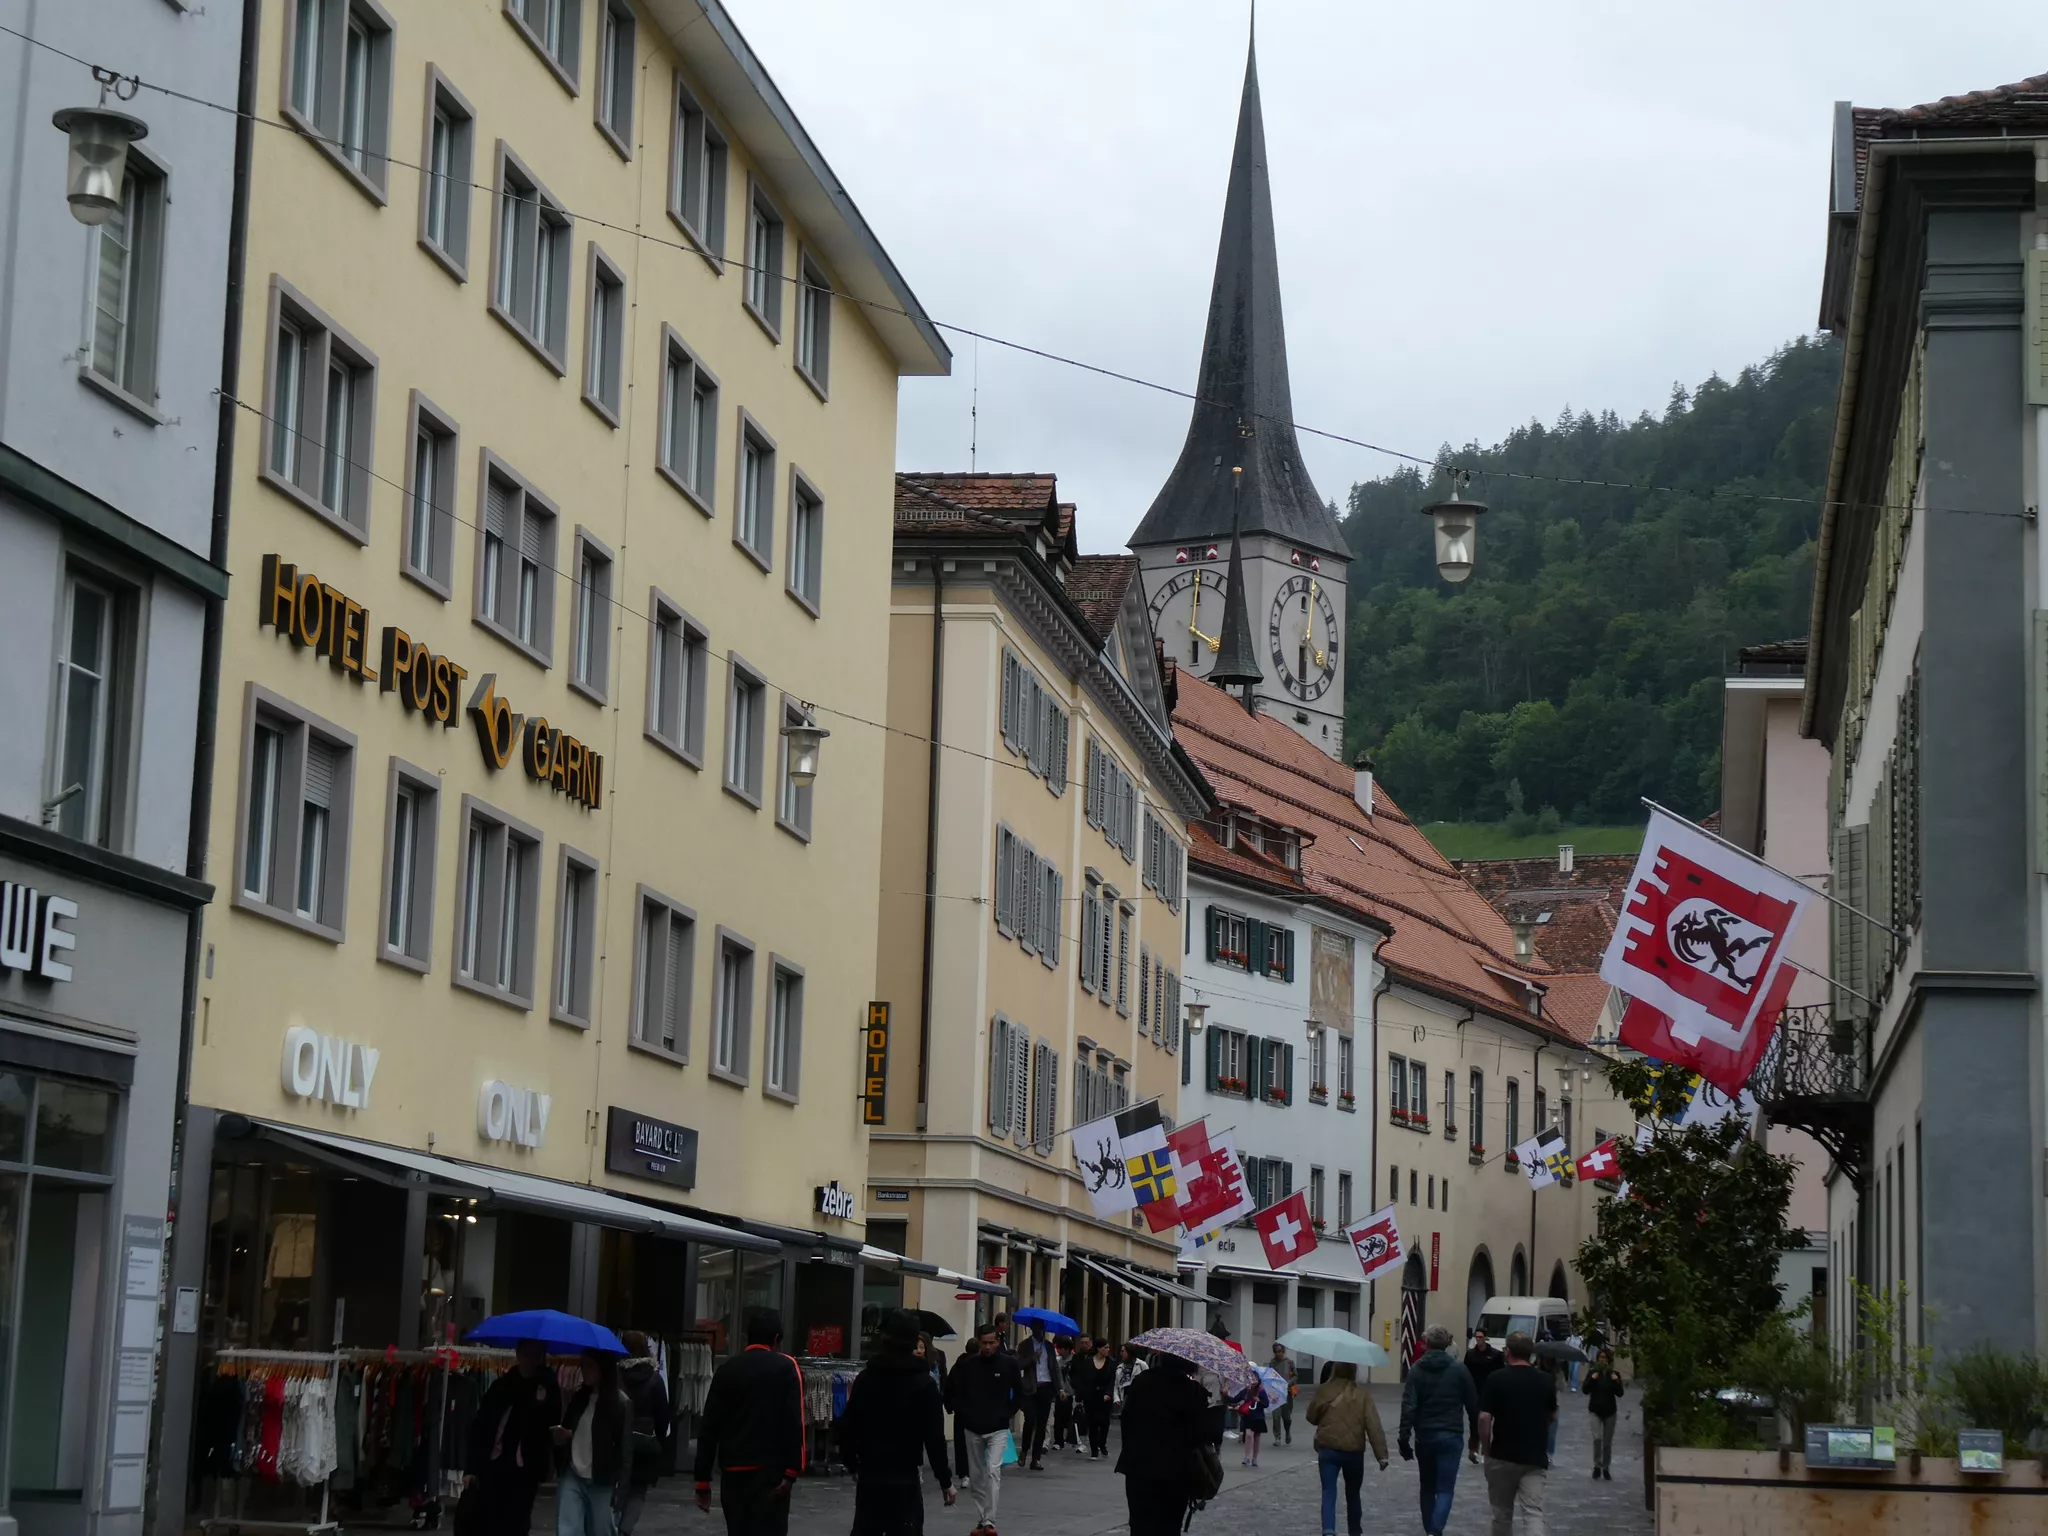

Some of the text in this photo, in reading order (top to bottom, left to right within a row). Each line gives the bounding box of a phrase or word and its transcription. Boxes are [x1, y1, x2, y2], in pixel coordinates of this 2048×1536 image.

[260, 553, 604, 811] HOTEL POST GARNI
[281, 1026, 380, 1110] ONLY
[865, 1005, 887, 1121] HOTEL
[477, 1079, 552, 1148] ONLY
[635, 1121, 663, 1150] BAYARD
[819, 1181, 854, 1219] zebra
[877, 1191, 908, 1199] Bankstrasse
